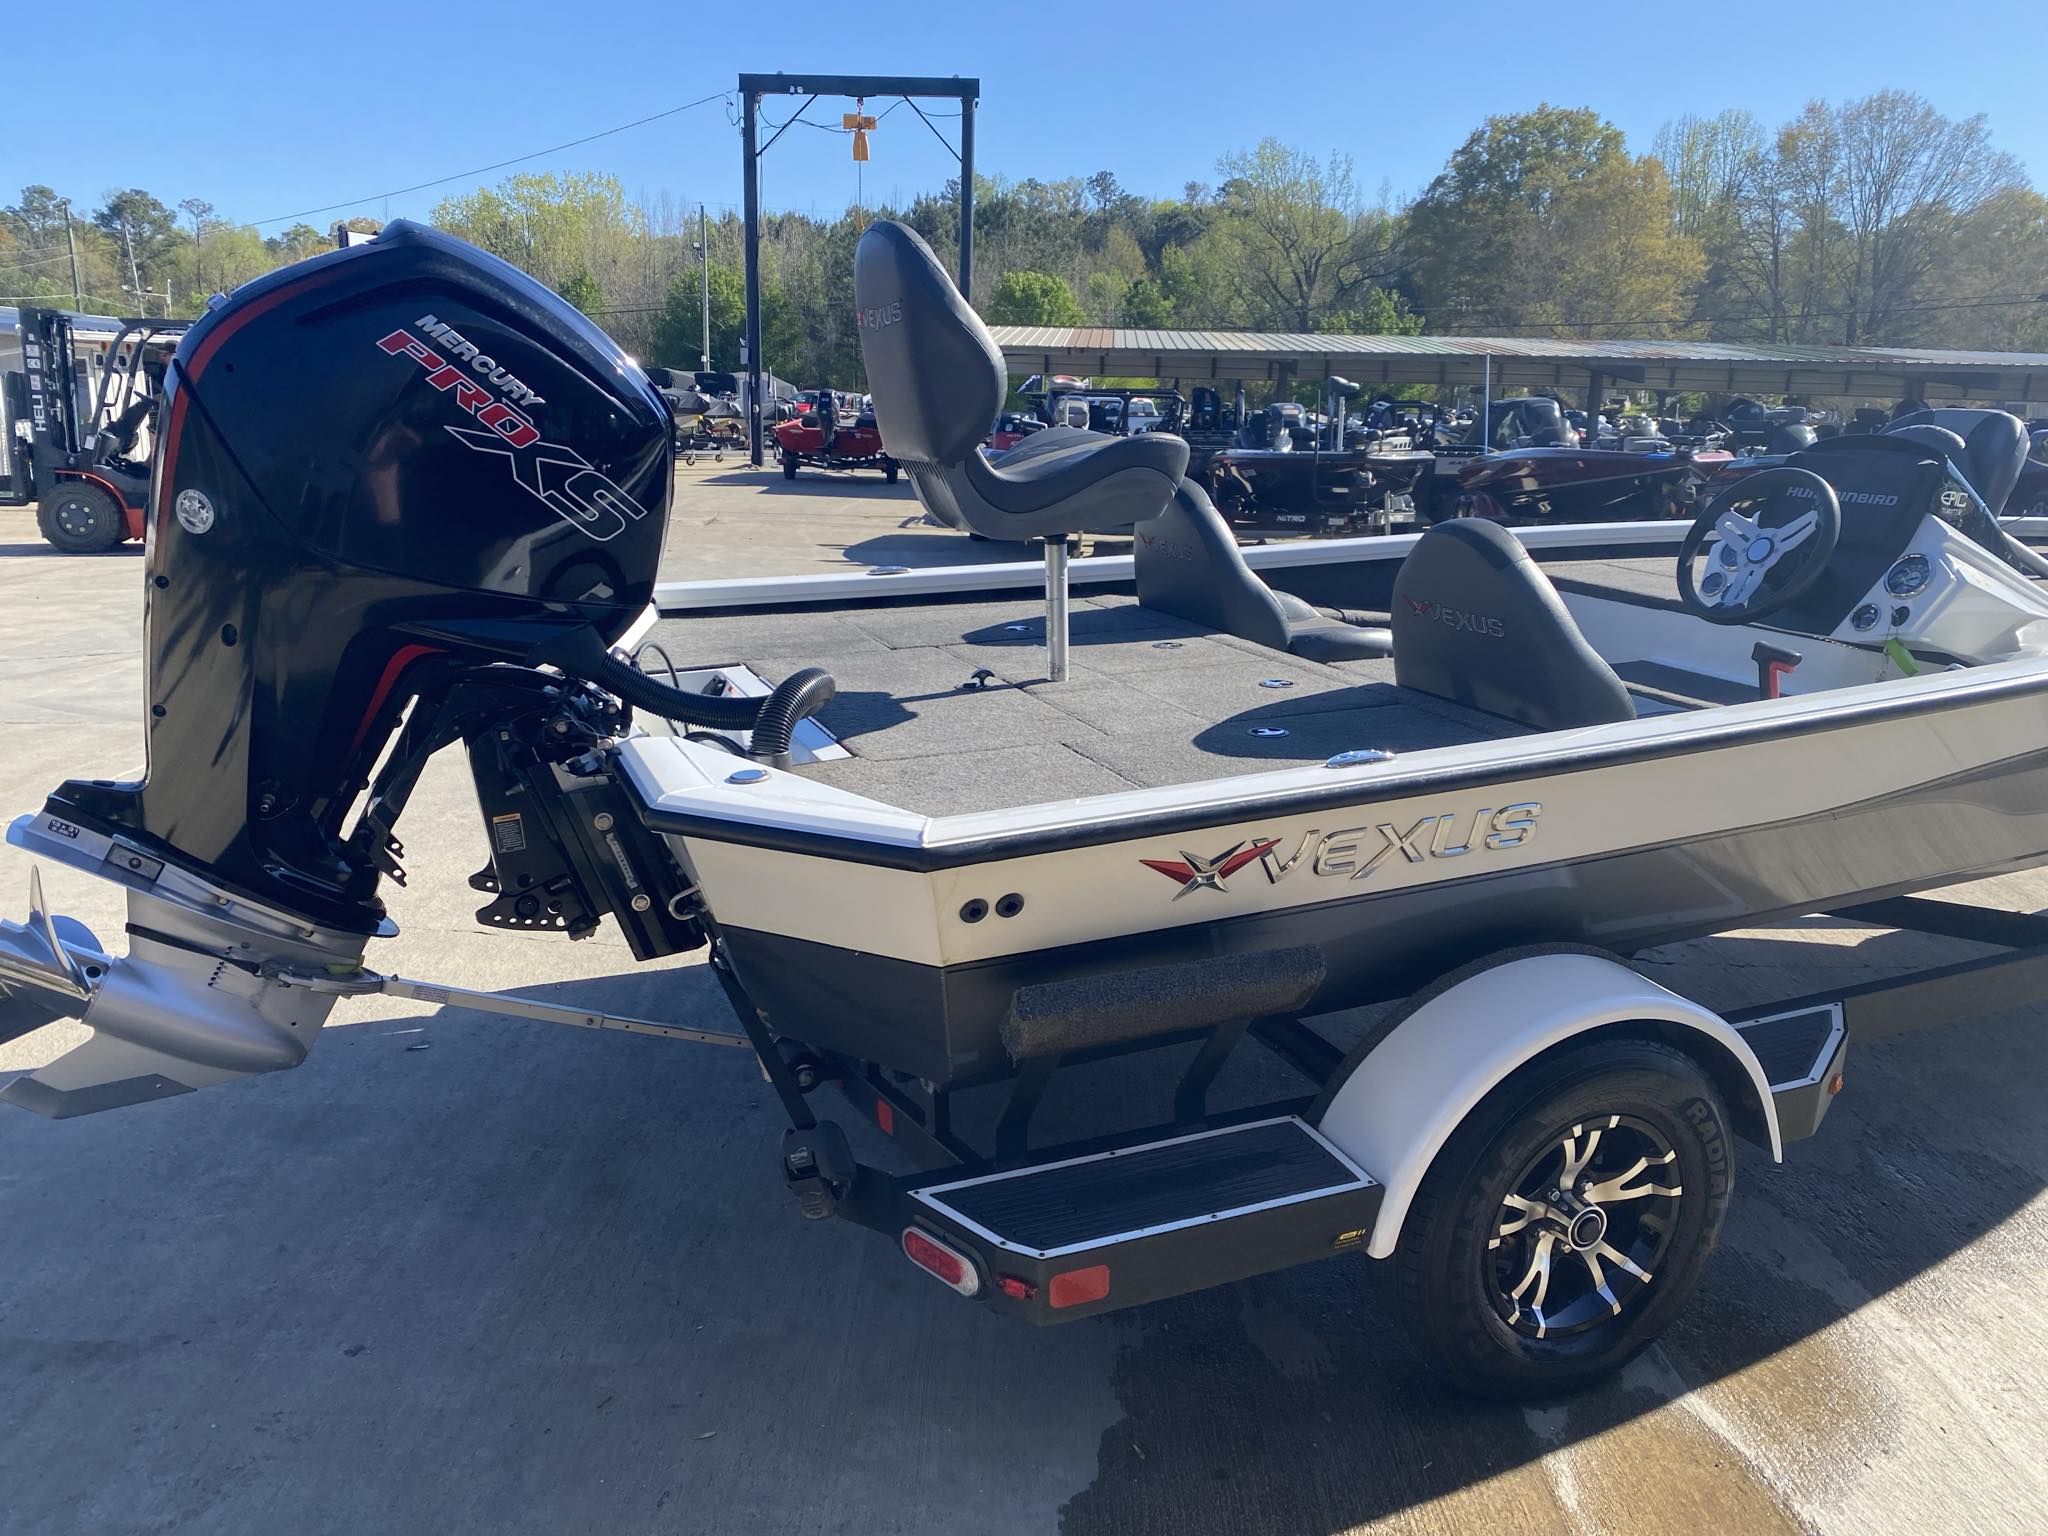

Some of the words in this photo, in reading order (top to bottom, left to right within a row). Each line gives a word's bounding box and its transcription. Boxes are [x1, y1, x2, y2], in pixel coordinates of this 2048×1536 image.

[376, 329, 541, 449] PRO
[414, 314, 546, 407] MERCURY
[32, 394, 47, 432] HELI
[443, 397, 648, 542] XS
[1940, 490, 1968, 508] EPIC
[1430, 602, 1505, 638] VEXUS
[1251, 801, 1543, 885] VEXUS
[1686, 1100, 1729, 1209] RADIAL
